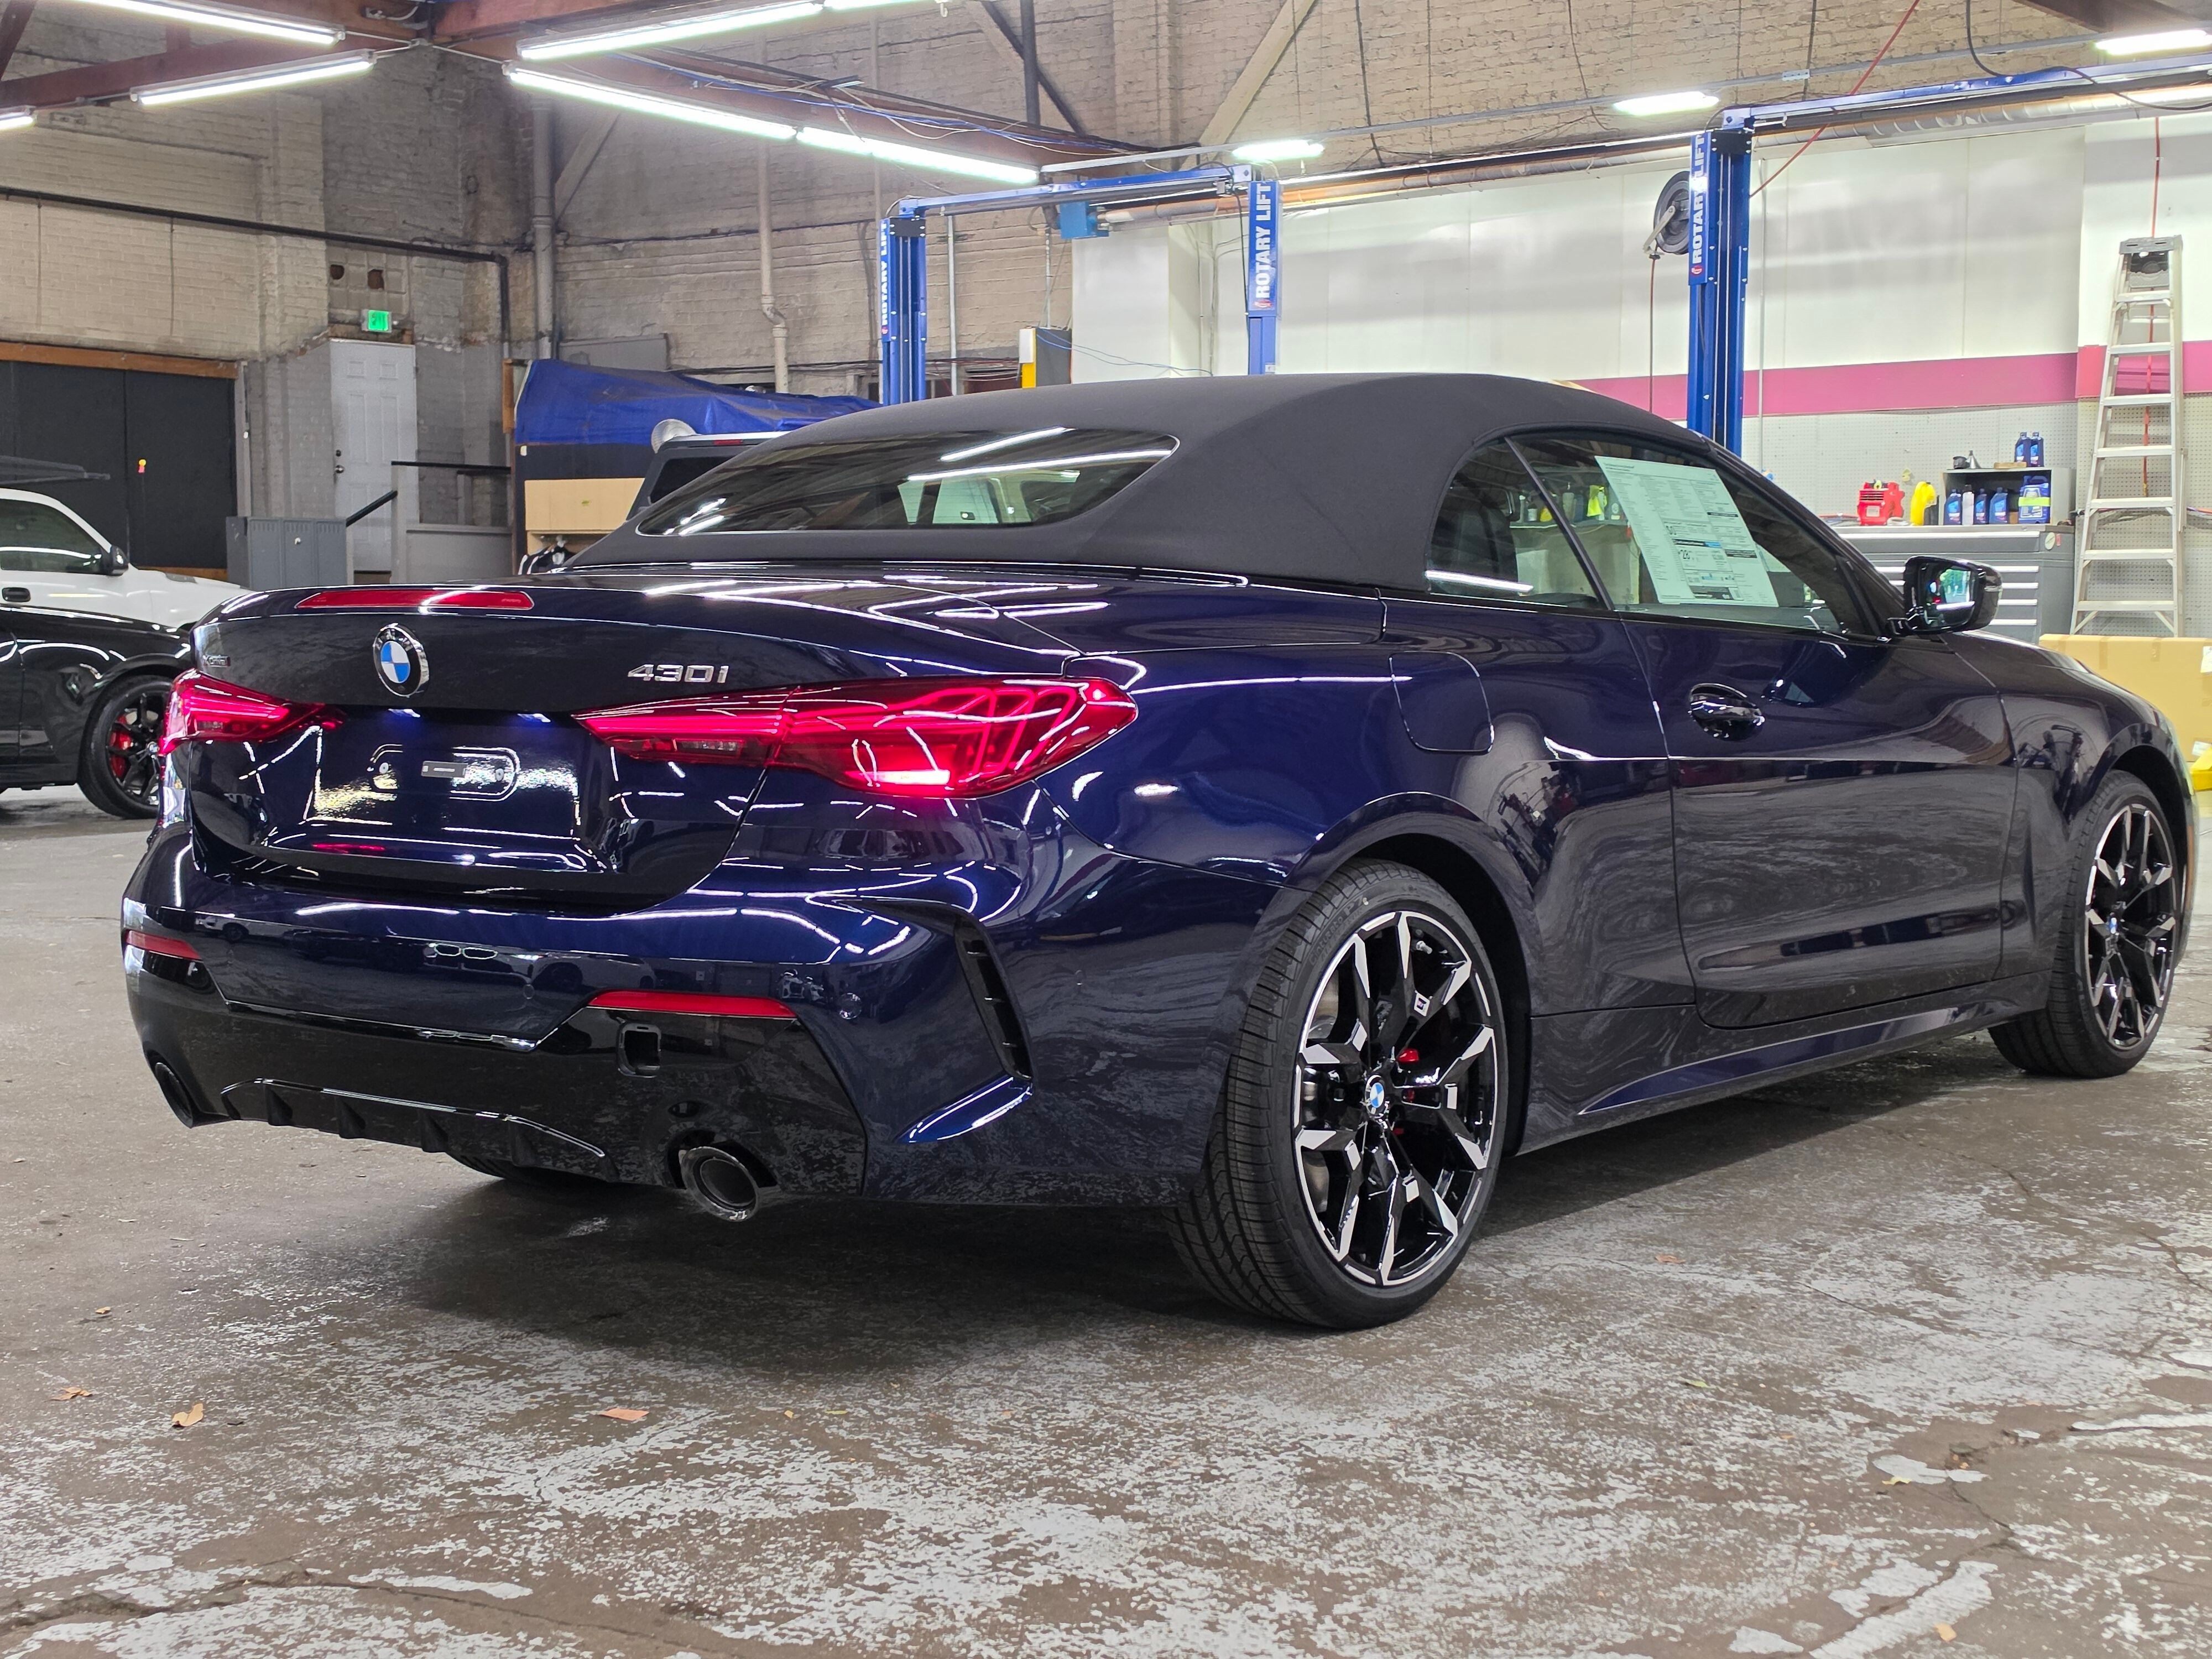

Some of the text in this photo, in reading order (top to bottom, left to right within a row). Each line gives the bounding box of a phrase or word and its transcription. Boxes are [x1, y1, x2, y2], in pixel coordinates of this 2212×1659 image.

[1692, 134, 1705, 264] ROTAR LIFT
[1255, 183, 1271, 298] ROTARY LIFT
[628, 664, 729, 683] 430i
[1343, 894, 1365, 916] P7
